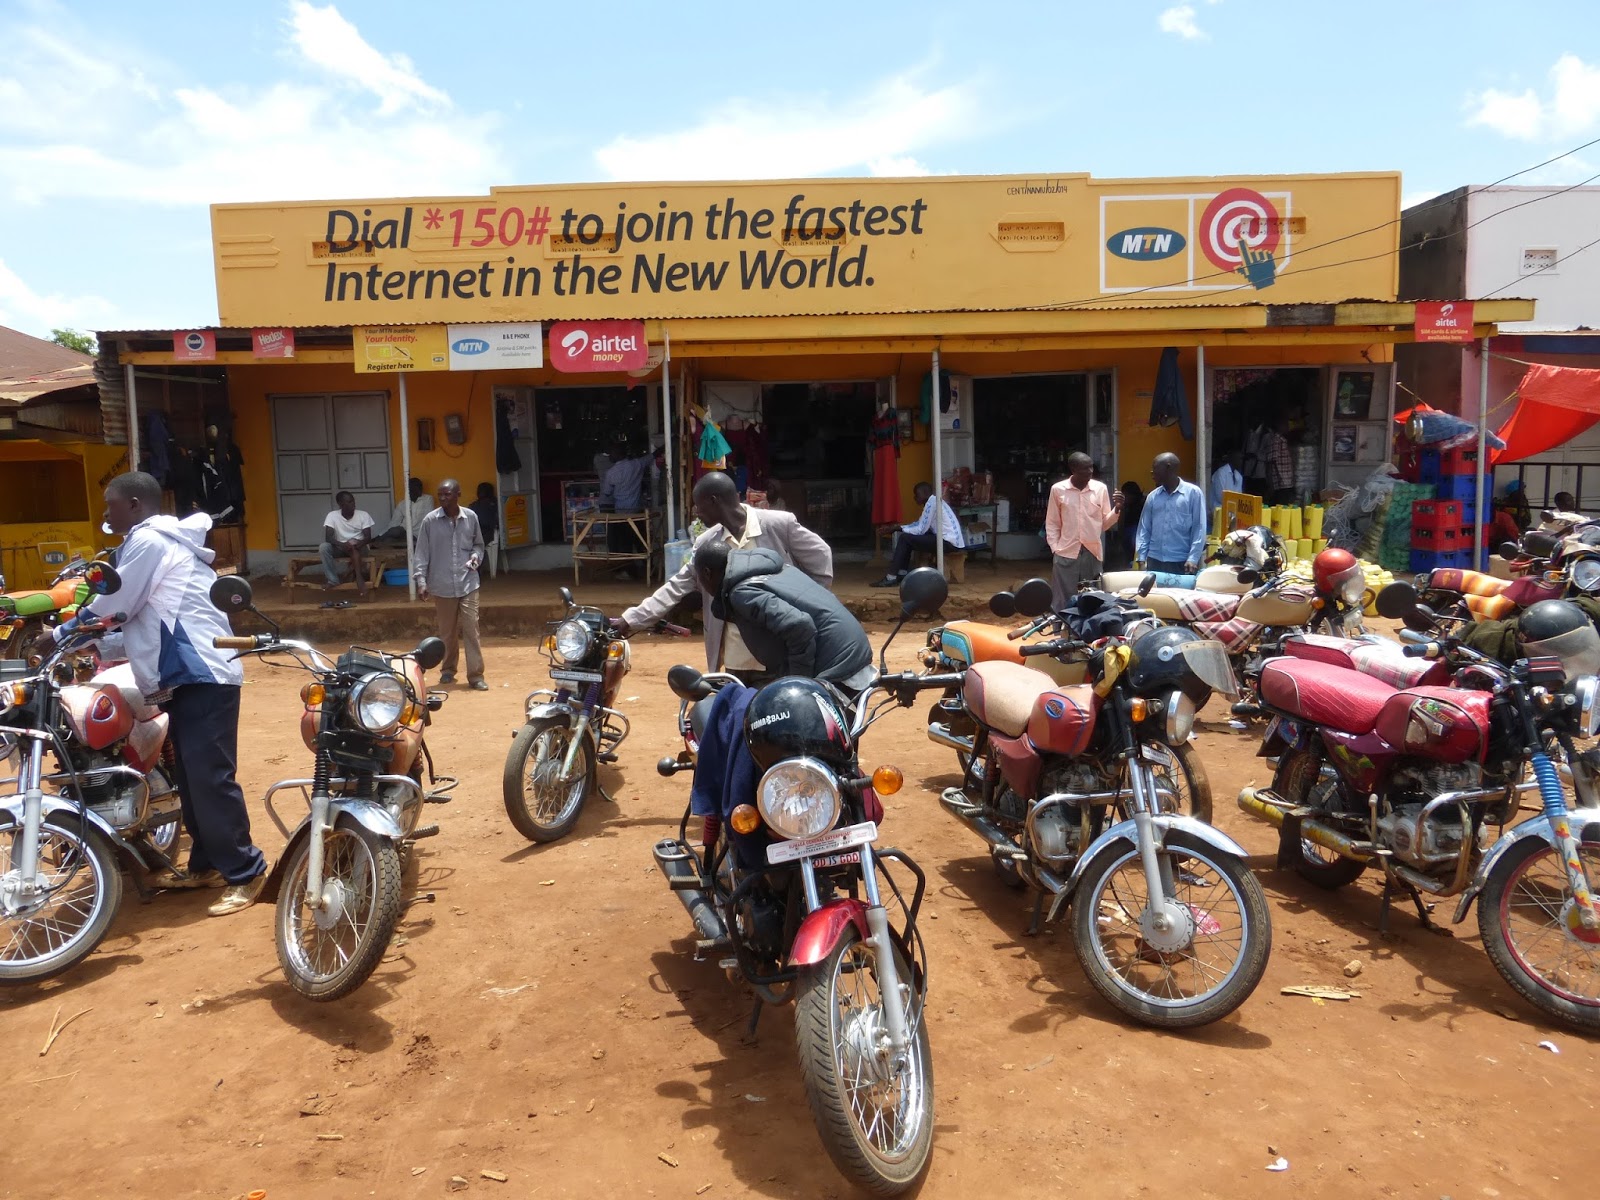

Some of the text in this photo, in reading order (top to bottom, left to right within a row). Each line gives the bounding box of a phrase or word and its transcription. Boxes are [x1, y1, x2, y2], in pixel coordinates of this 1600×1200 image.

[325, 207, 413, 254] Dial
[560, 208, 604, 245] to
[608, 201, 693, 254] join
[705, 197, 774, 241] the
[784, 194, 927, 241] fastest
[1121, 234, 1173, 254] MTN
[324, 244, 875, 302] Internet in the New World.
[1435, 318, 1457, 327] airtel
[258, 330, 285, 346] Hedex
[365, 334, 418, 343] Your Identity.
[591, 335, 637, 352] airtel
[459, 342, 482, 352] MTN
[592, 353, 624, 363] money
[366, 363, 396, 371] Register
[44, 553, 64, 562] MTN
[771, 710, 790, 722] BAJAJ
[829, 855, 837, 865] IS
[840, 852, 859, 864] GOD
